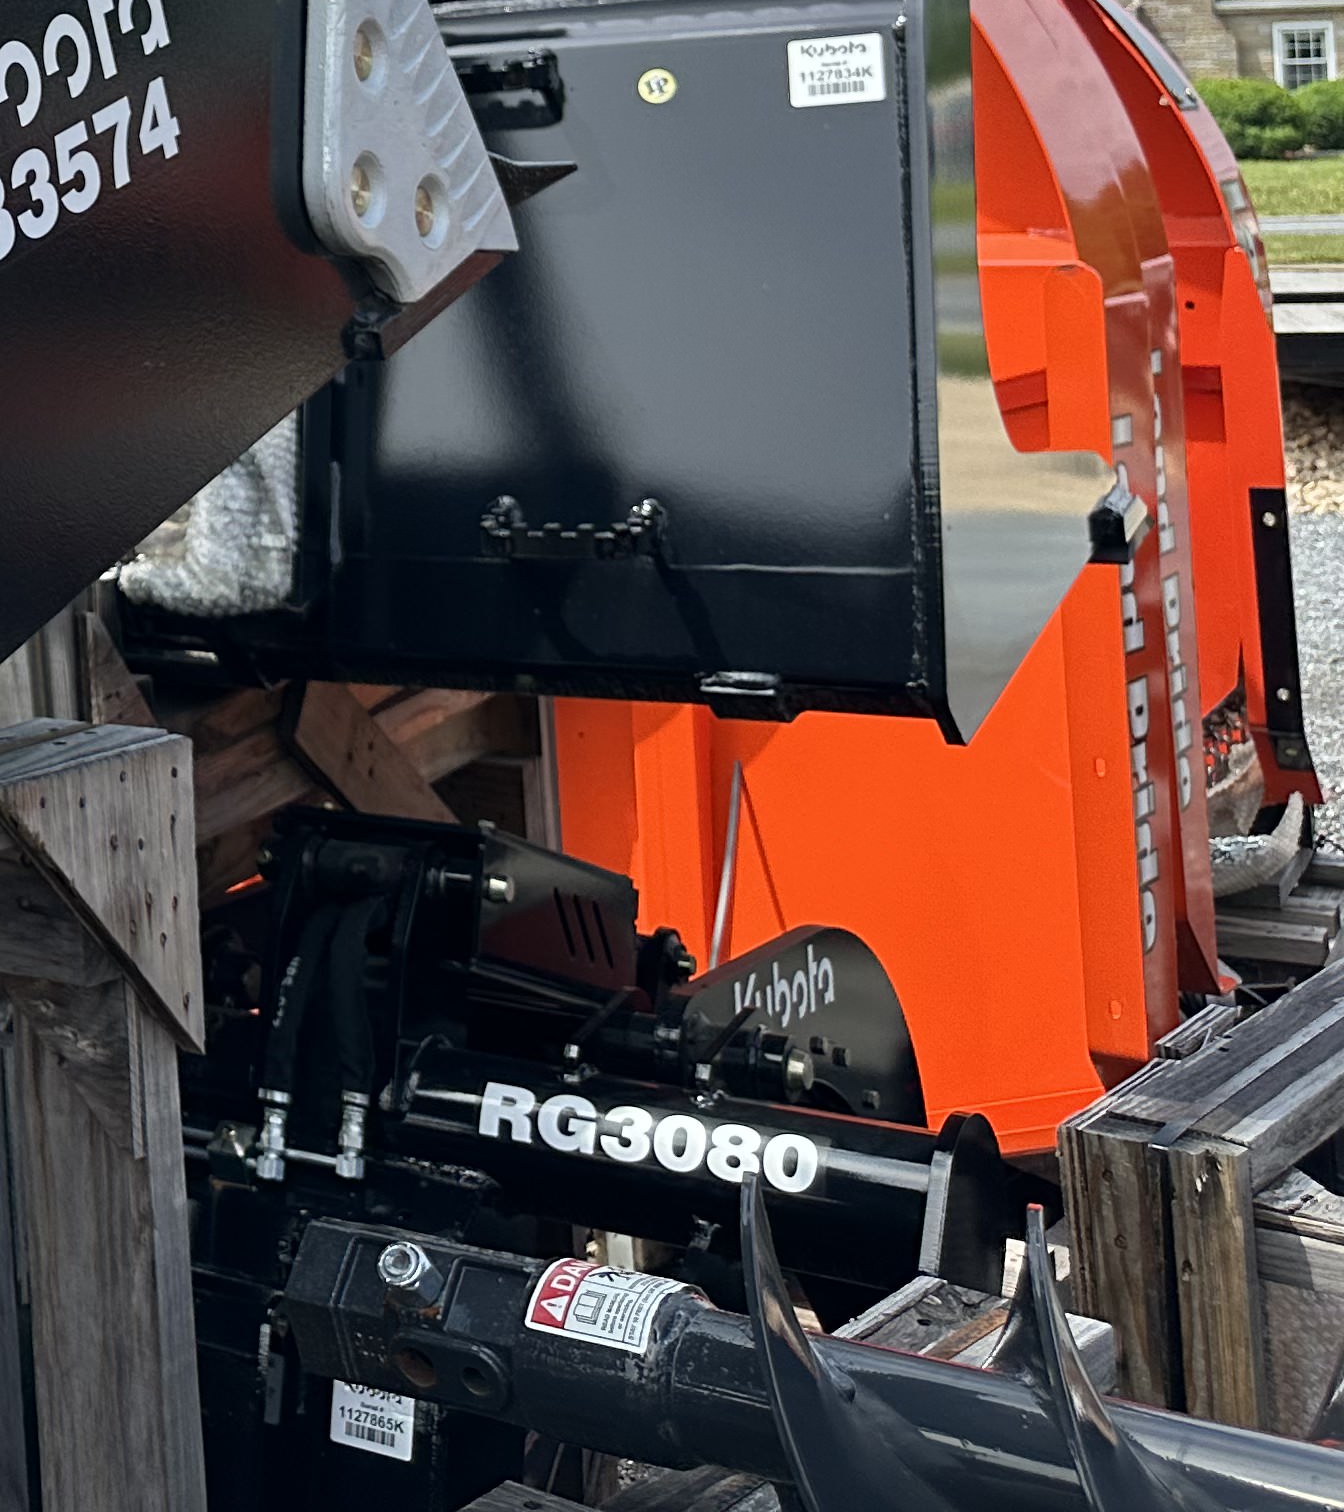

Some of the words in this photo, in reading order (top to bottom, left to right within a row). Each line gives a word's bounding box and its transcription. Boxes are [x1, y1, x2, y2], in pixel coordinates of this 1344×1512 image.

[800, 41, 867, 57] Kubota
[734, 944, 835, 1028] Kubota
[478, 1080, 819, 1193] RG3080
[339, 1406, 404, 1433] 1127865K
